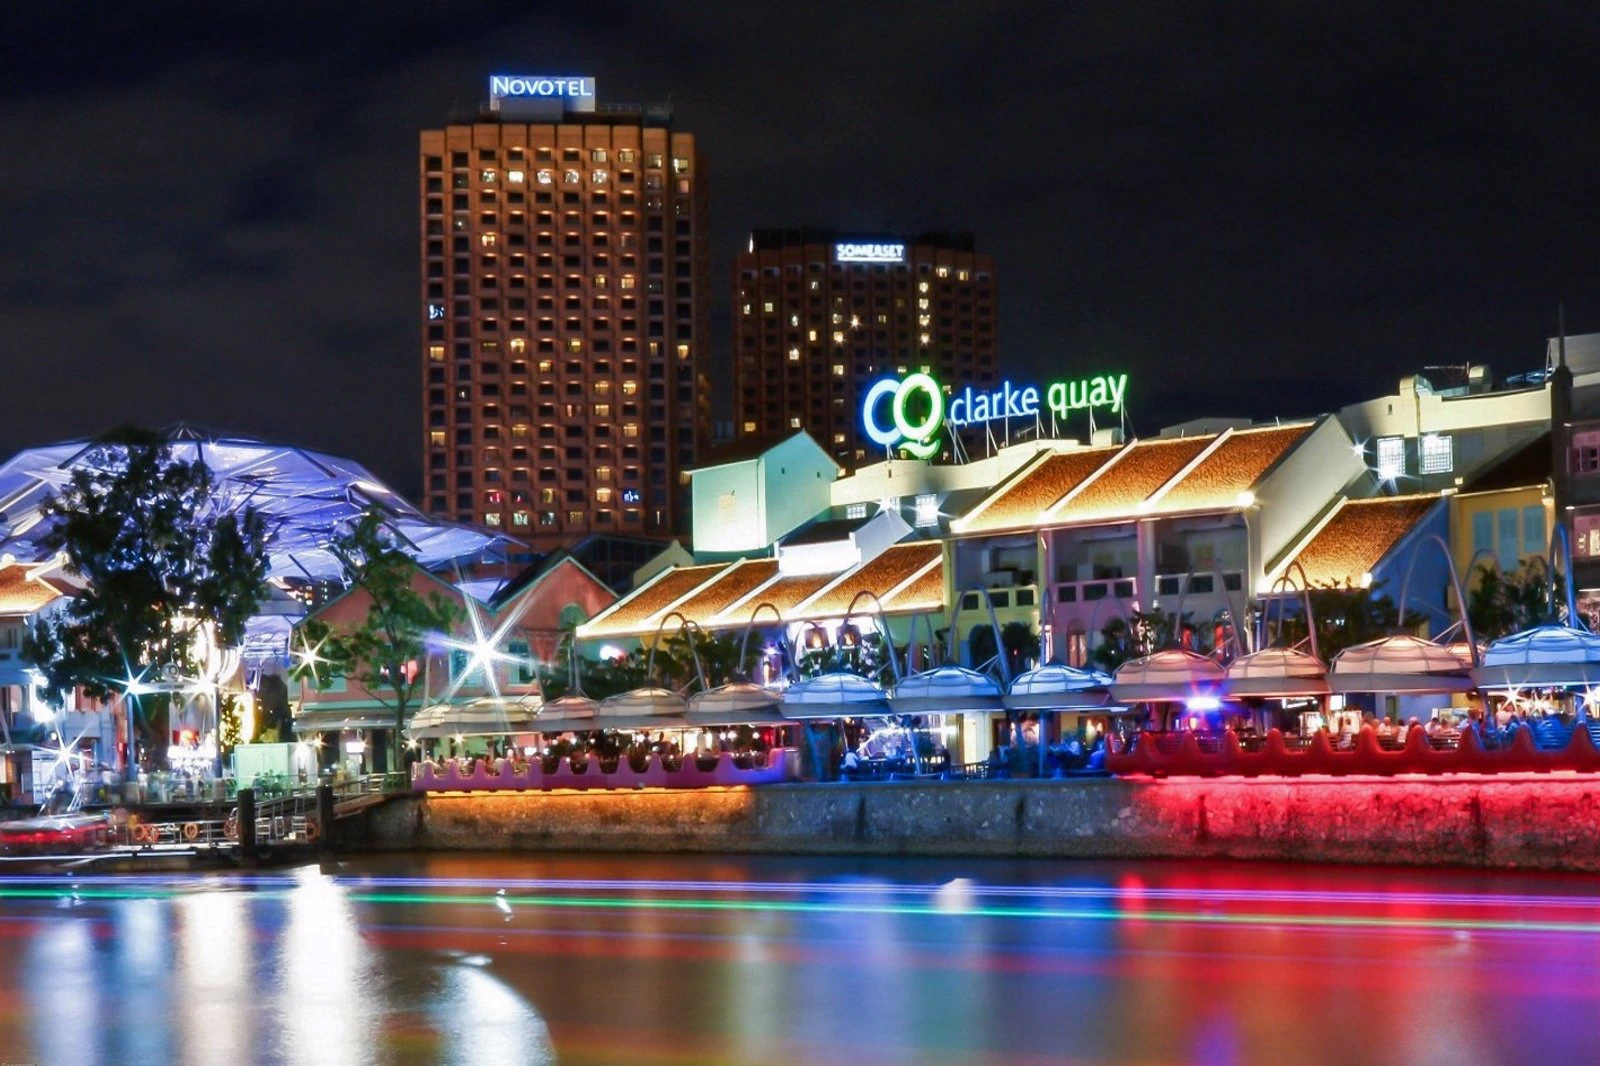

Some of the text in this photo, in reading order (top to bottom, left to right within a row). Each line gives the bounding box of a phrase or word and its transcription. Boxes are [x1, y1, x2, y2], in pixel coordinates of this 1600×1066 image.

[491, 76, 593, 97] NOVOTEL
[836, 243, 905, 258] SOMERSET
[863, 373, 1127, 459] CQ clarke quay
